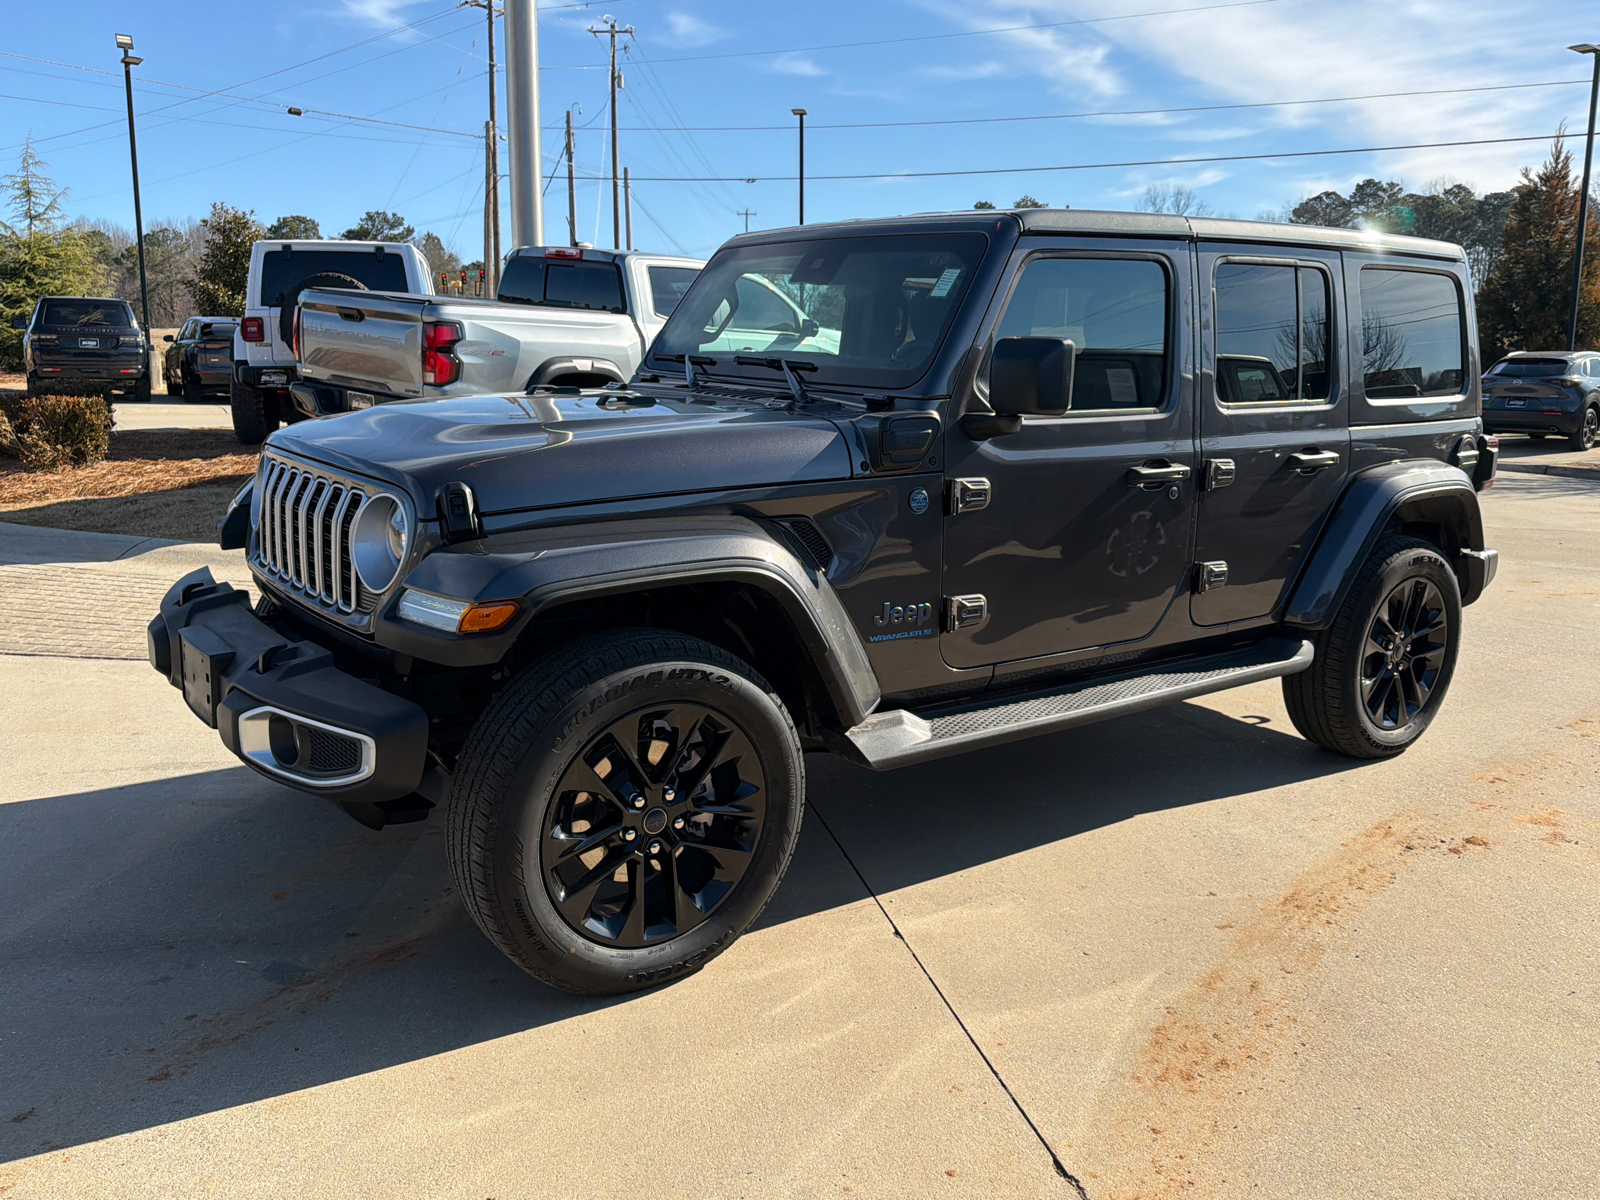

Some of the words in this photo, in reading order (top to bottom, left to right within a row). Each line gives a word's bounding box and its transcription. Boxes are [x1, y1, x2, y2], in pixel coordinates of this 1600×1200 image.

[1410, 555, 1446, 571] NEXEN
[873, 601, 932, 627] Jeep
[869, 630, 922, 642] WRANGLER
[562, 670, 664, 737] ROADIAN
[667, 668, 714, 682] HTX
[715, 675, 731, 688] 2
[513, 897, 549, 951] All-Weather
[635, 936, 728, 983] NEXEN
